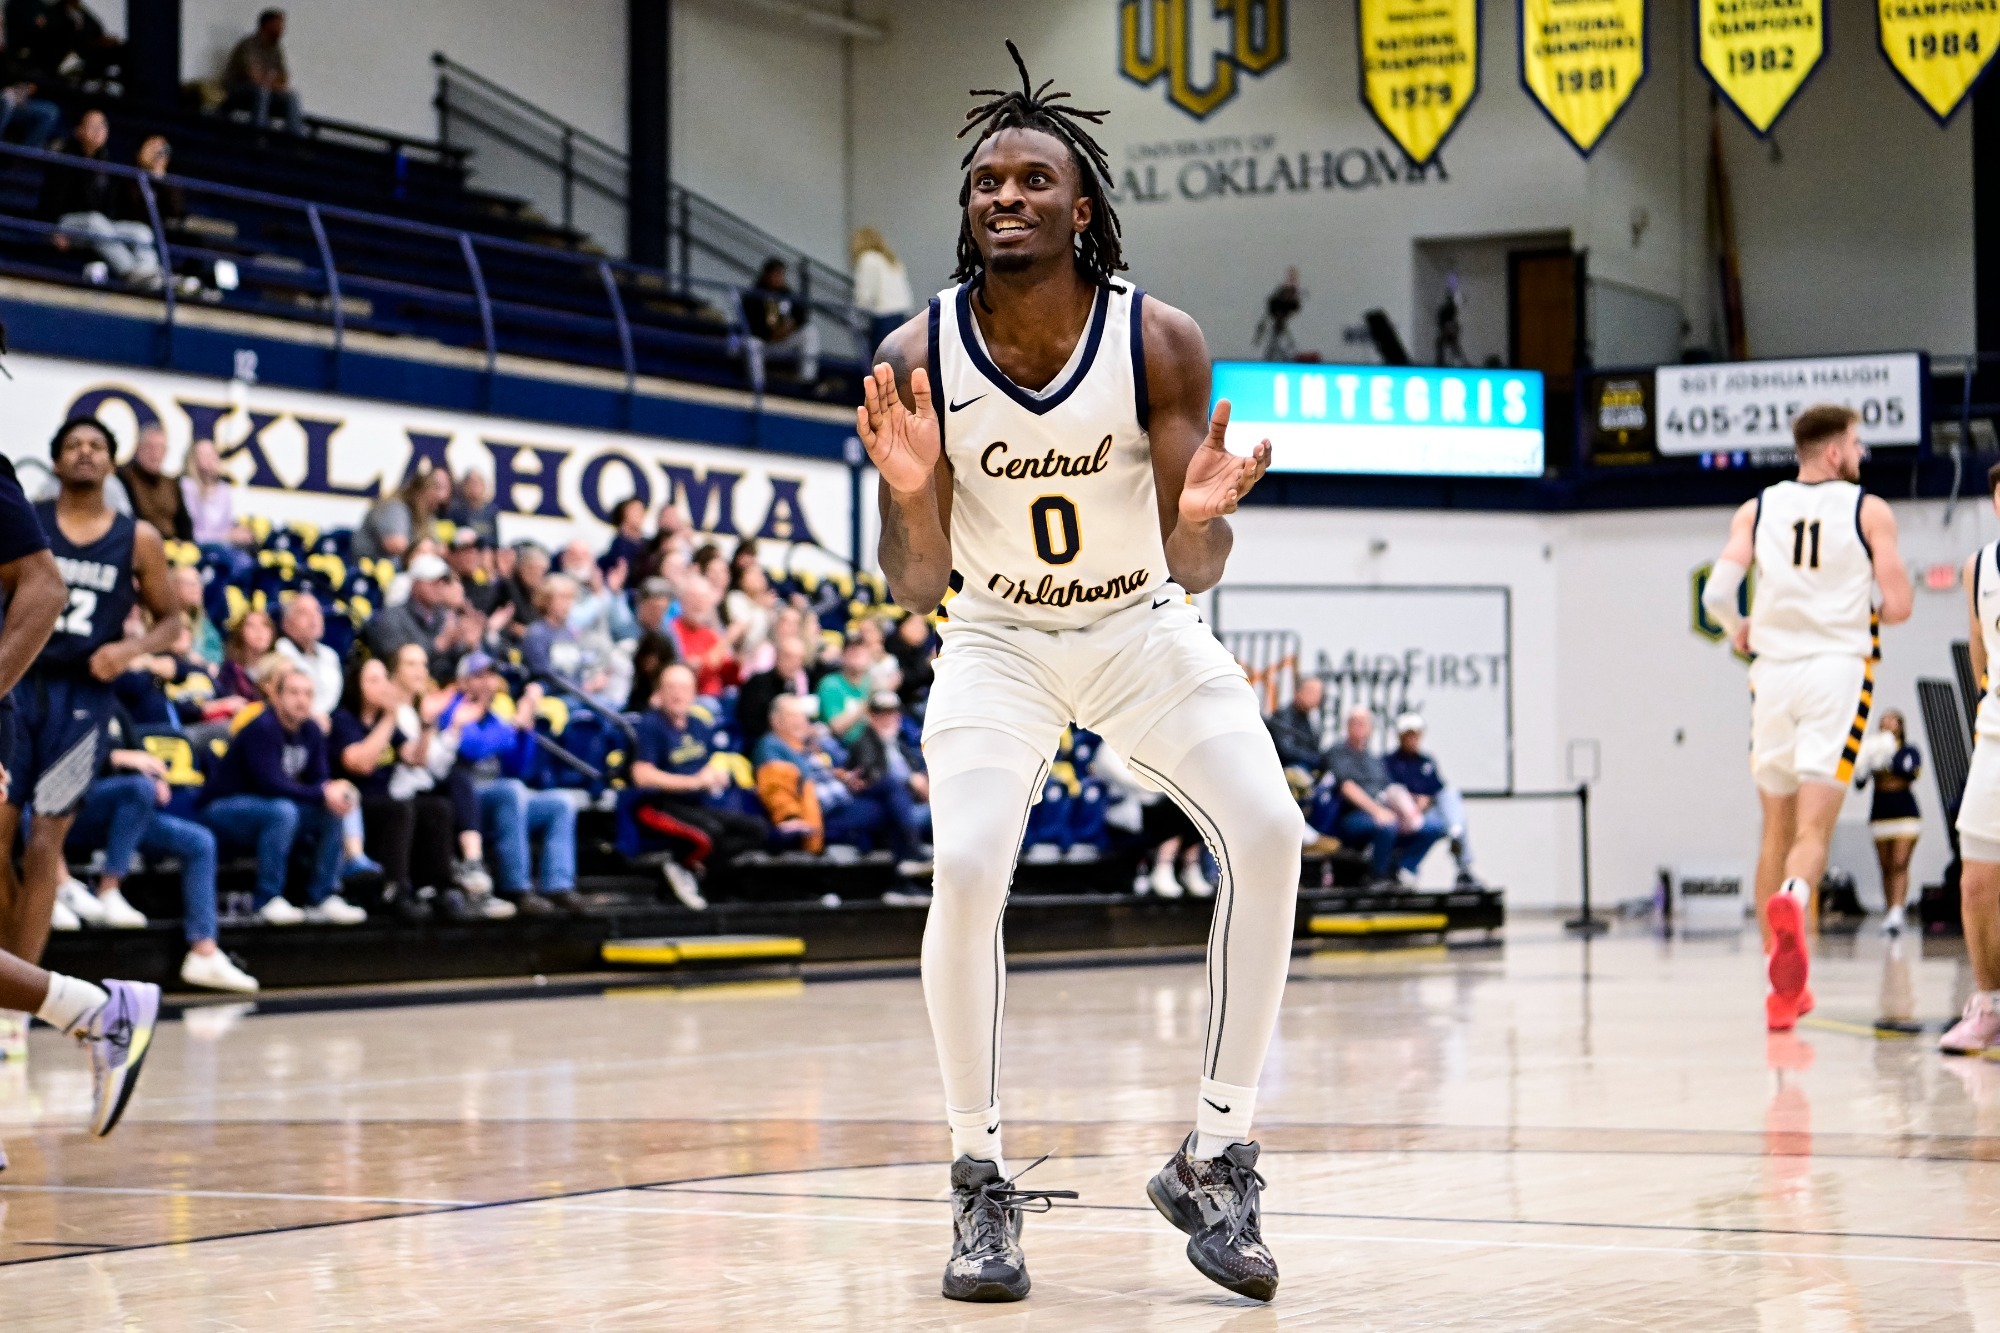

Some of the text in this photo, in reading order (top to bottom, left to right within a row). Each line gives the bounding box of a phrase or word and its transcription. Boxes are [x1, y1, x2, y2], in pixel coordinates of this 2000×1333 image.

[1727, 44, 1795, 78] 1982
[1907, 27, 1979, 61] 1984
[1555, 65, 1617, 94] 1981
[1272, 371, 1528, 426] INTEGRIS
[980, 433, 1113, 480] Central
[1792, 517, 1823, 570] 11
